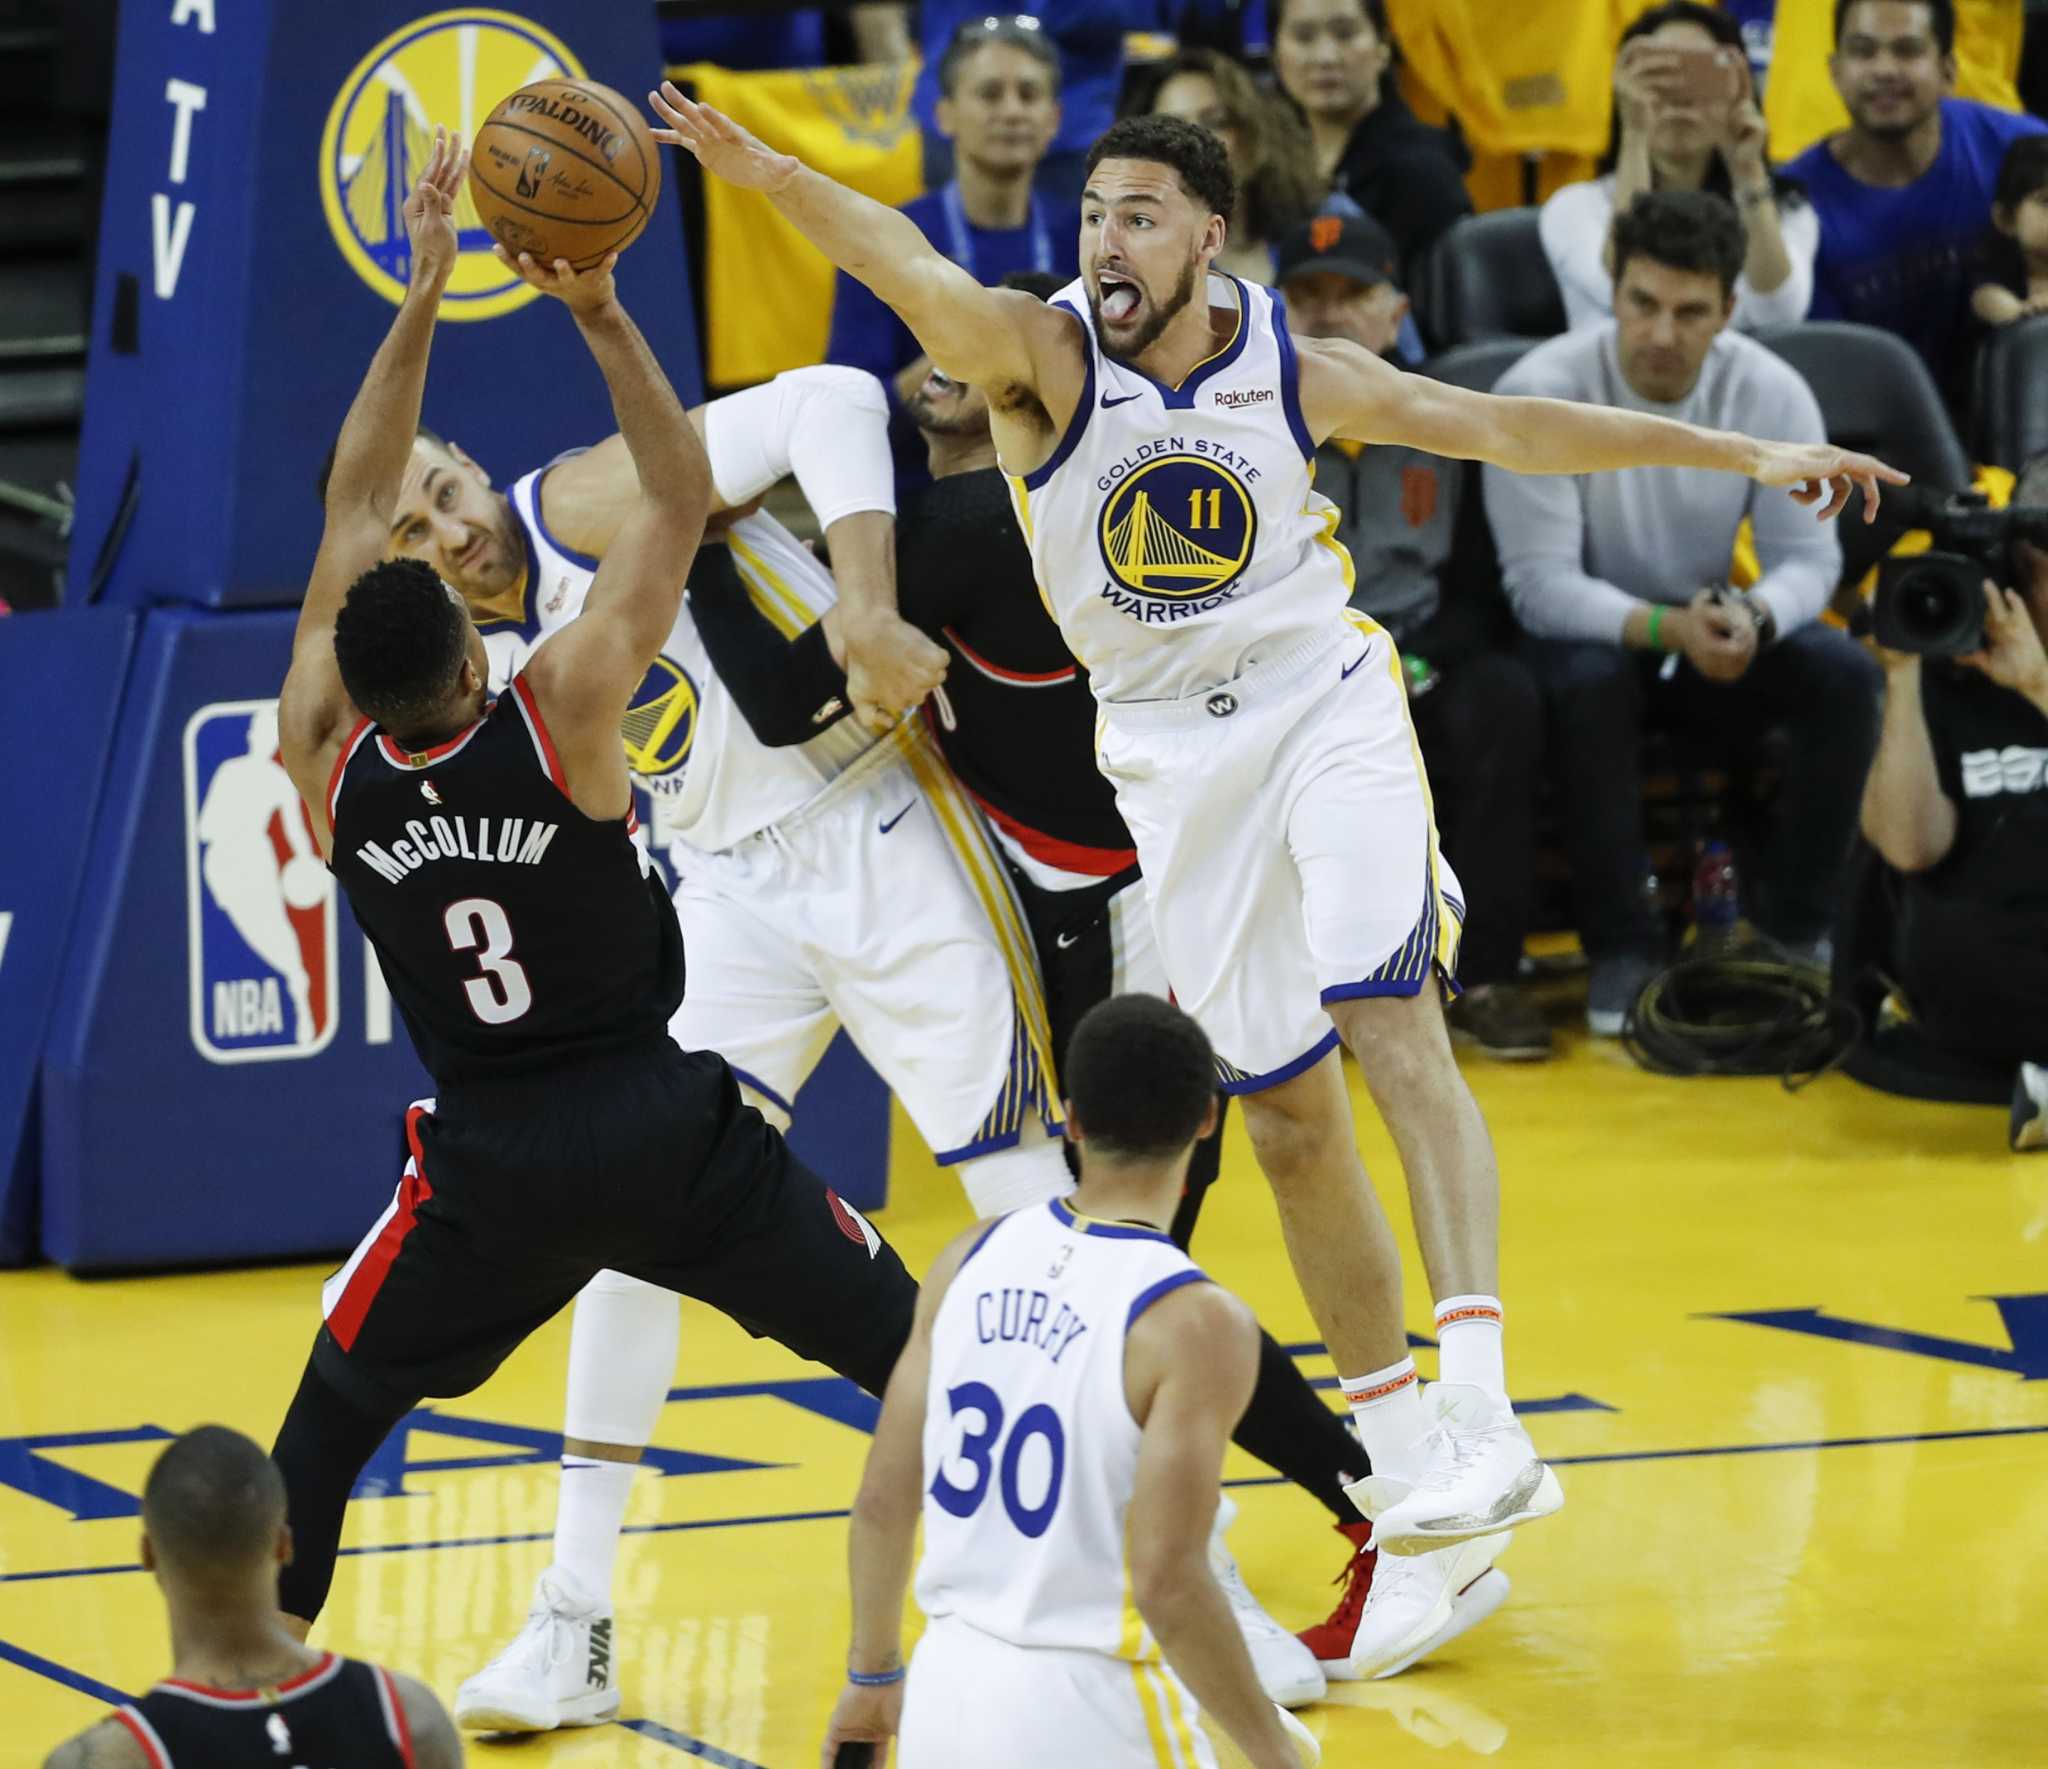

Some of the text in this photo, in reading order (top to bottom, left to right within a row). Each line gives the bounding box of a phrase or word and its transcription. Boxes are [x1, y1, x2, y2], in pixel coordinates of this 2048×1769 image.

[1214, 389, 1274, 409] Rakuten
[1097, 437, 1262, 492] GOLDEN STATE
[1188, 488, 1222, 530] 11
[1101, 579, 1241, 623] WARRIOR
[356, 815, 559, 885] McCOLLUM
[443, 897, 533, 1025] 3
[213, 976, 284, 1038] NBA
[976, 1287, 1088, 1364] CURRY
[929, 1381, 1065, 1539] 30
[587, 1616, 612, 1691] NIKE
